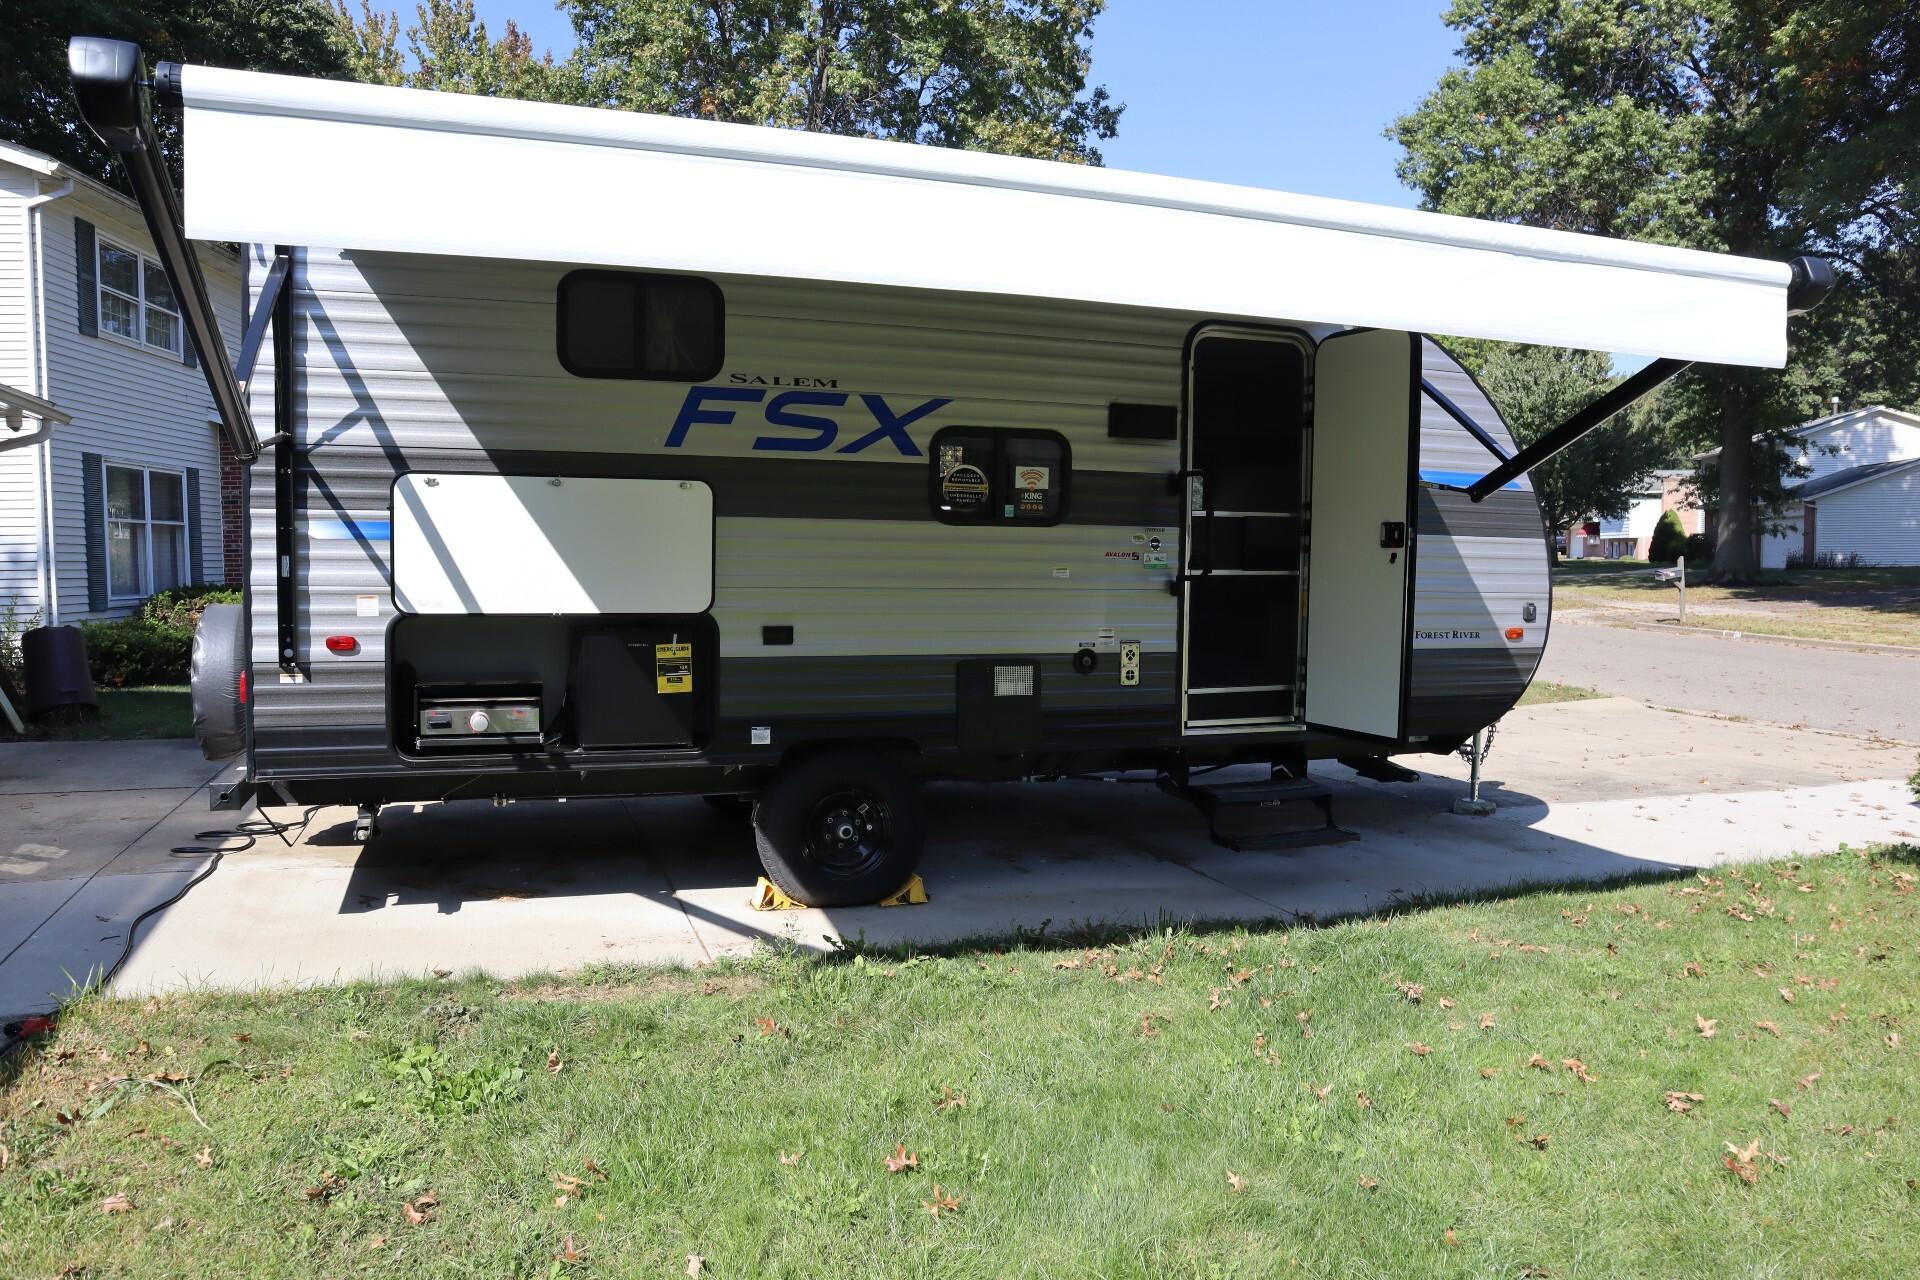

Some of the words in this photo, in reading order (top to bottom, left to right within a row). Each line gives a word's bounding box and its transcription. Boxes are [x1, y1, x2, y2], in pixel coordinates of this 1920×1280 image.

[729, 372, 838, 389] SALEM
[664, 385, 954, 456] FSX
[1024, 492, 1043, 500] KING
[1415, 630, 1450, 639] FOREST
[1452, 630, 1480, 639] RIVER
